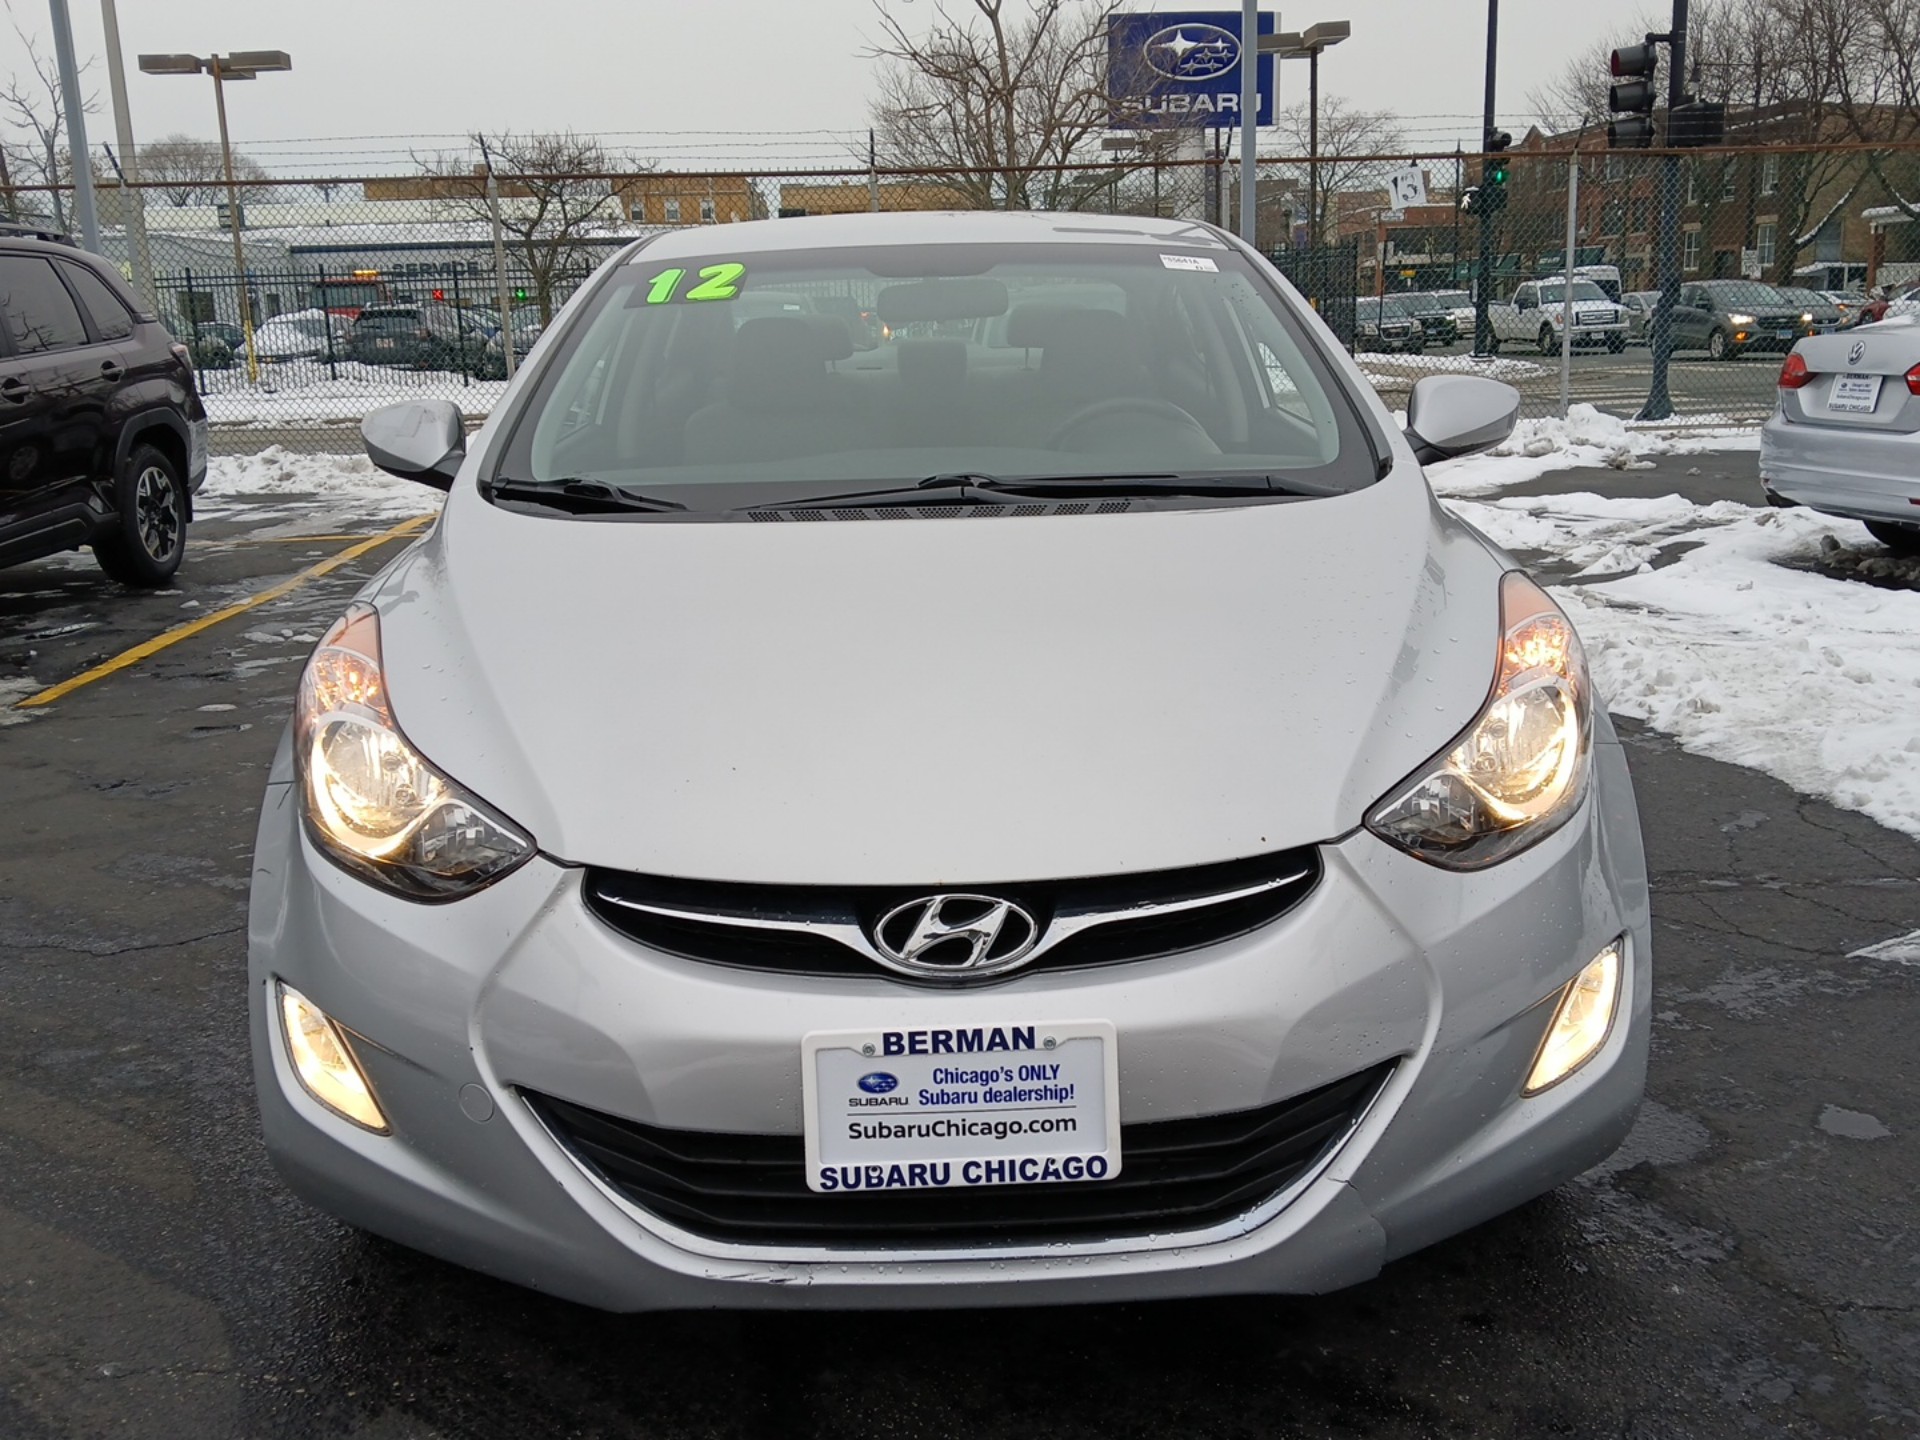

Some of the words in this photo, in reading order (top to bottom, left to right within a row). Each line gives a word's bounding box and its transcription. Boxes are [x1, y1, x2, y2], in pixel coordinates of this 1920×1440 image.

[392, 262, 479, 277] SERVICE
[646, 262, 746, 304] 12
[882, 1026, 1036, 1056] BERMAN
[932, 1066, 1014, 1087] Chicago's
[1018, 1064, 1061, 1081] ONLY
[848, 1097, 909, 1107] SUBARU
[918, 1088, 978, 1106] Subaru
[983, 1084, 1075, 1105] dealership!
[848, 1116, 1077, 1140] SubaruChicago.com
[819, 1162, 951, 1190] SUBARU
[962, 1155, 1109, 1184] CHICAGO
